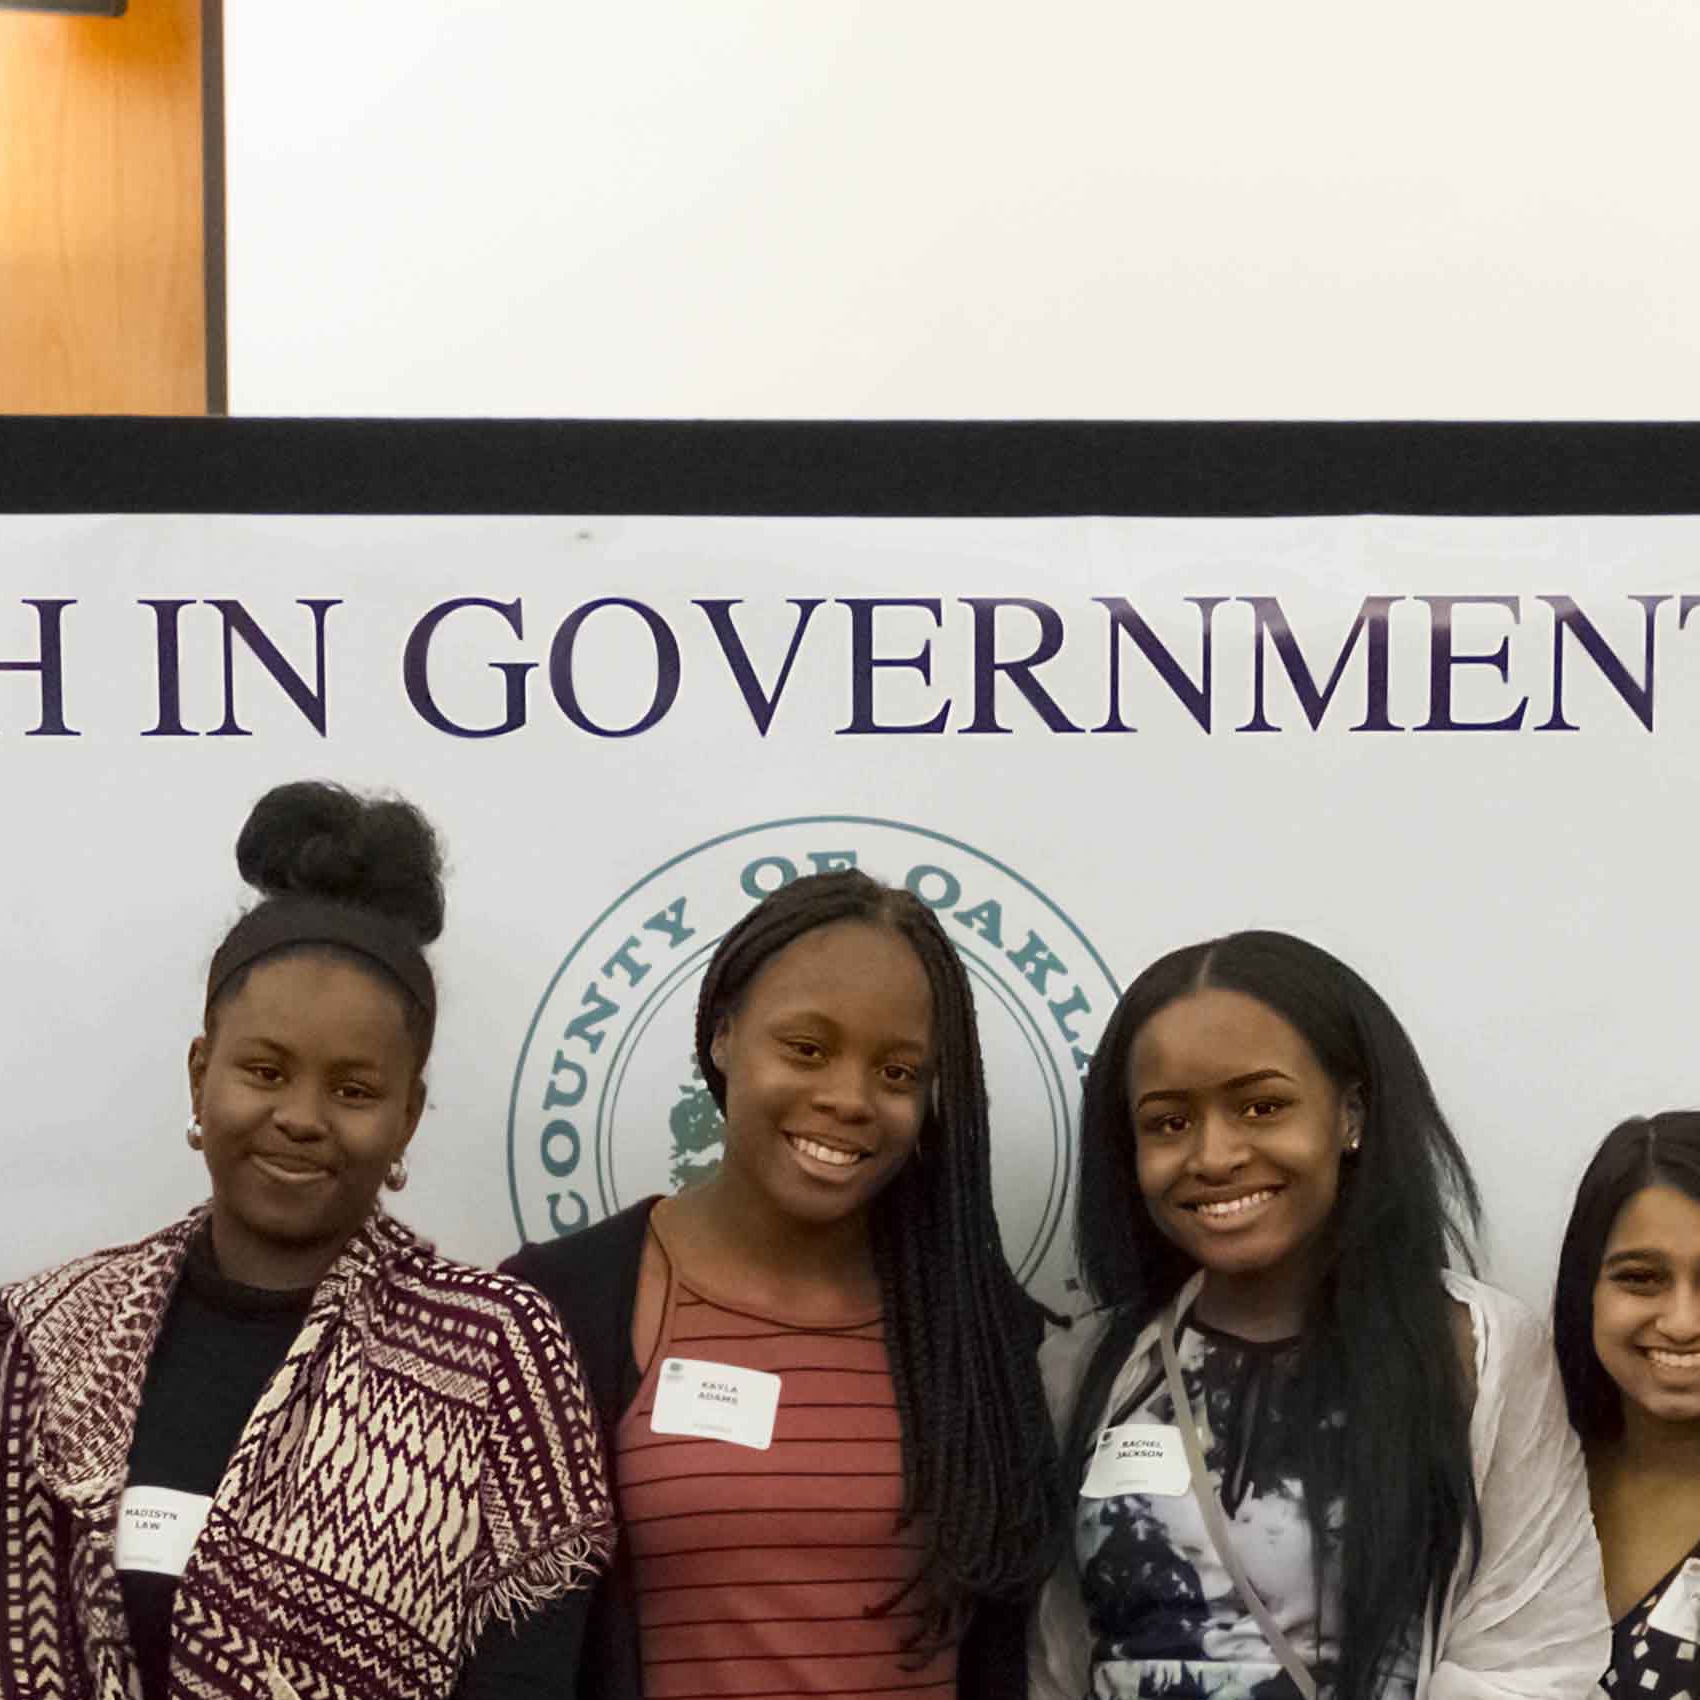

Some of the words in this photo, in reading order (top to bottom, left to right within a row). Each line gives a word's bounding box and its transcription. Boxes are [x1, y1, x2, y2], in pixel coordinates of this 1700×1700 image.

[137, 598, 344, 738] IN
[539, 895, 696, 1238] COUNTY
[1115, 1449, 1164, 1460] JACKSON
